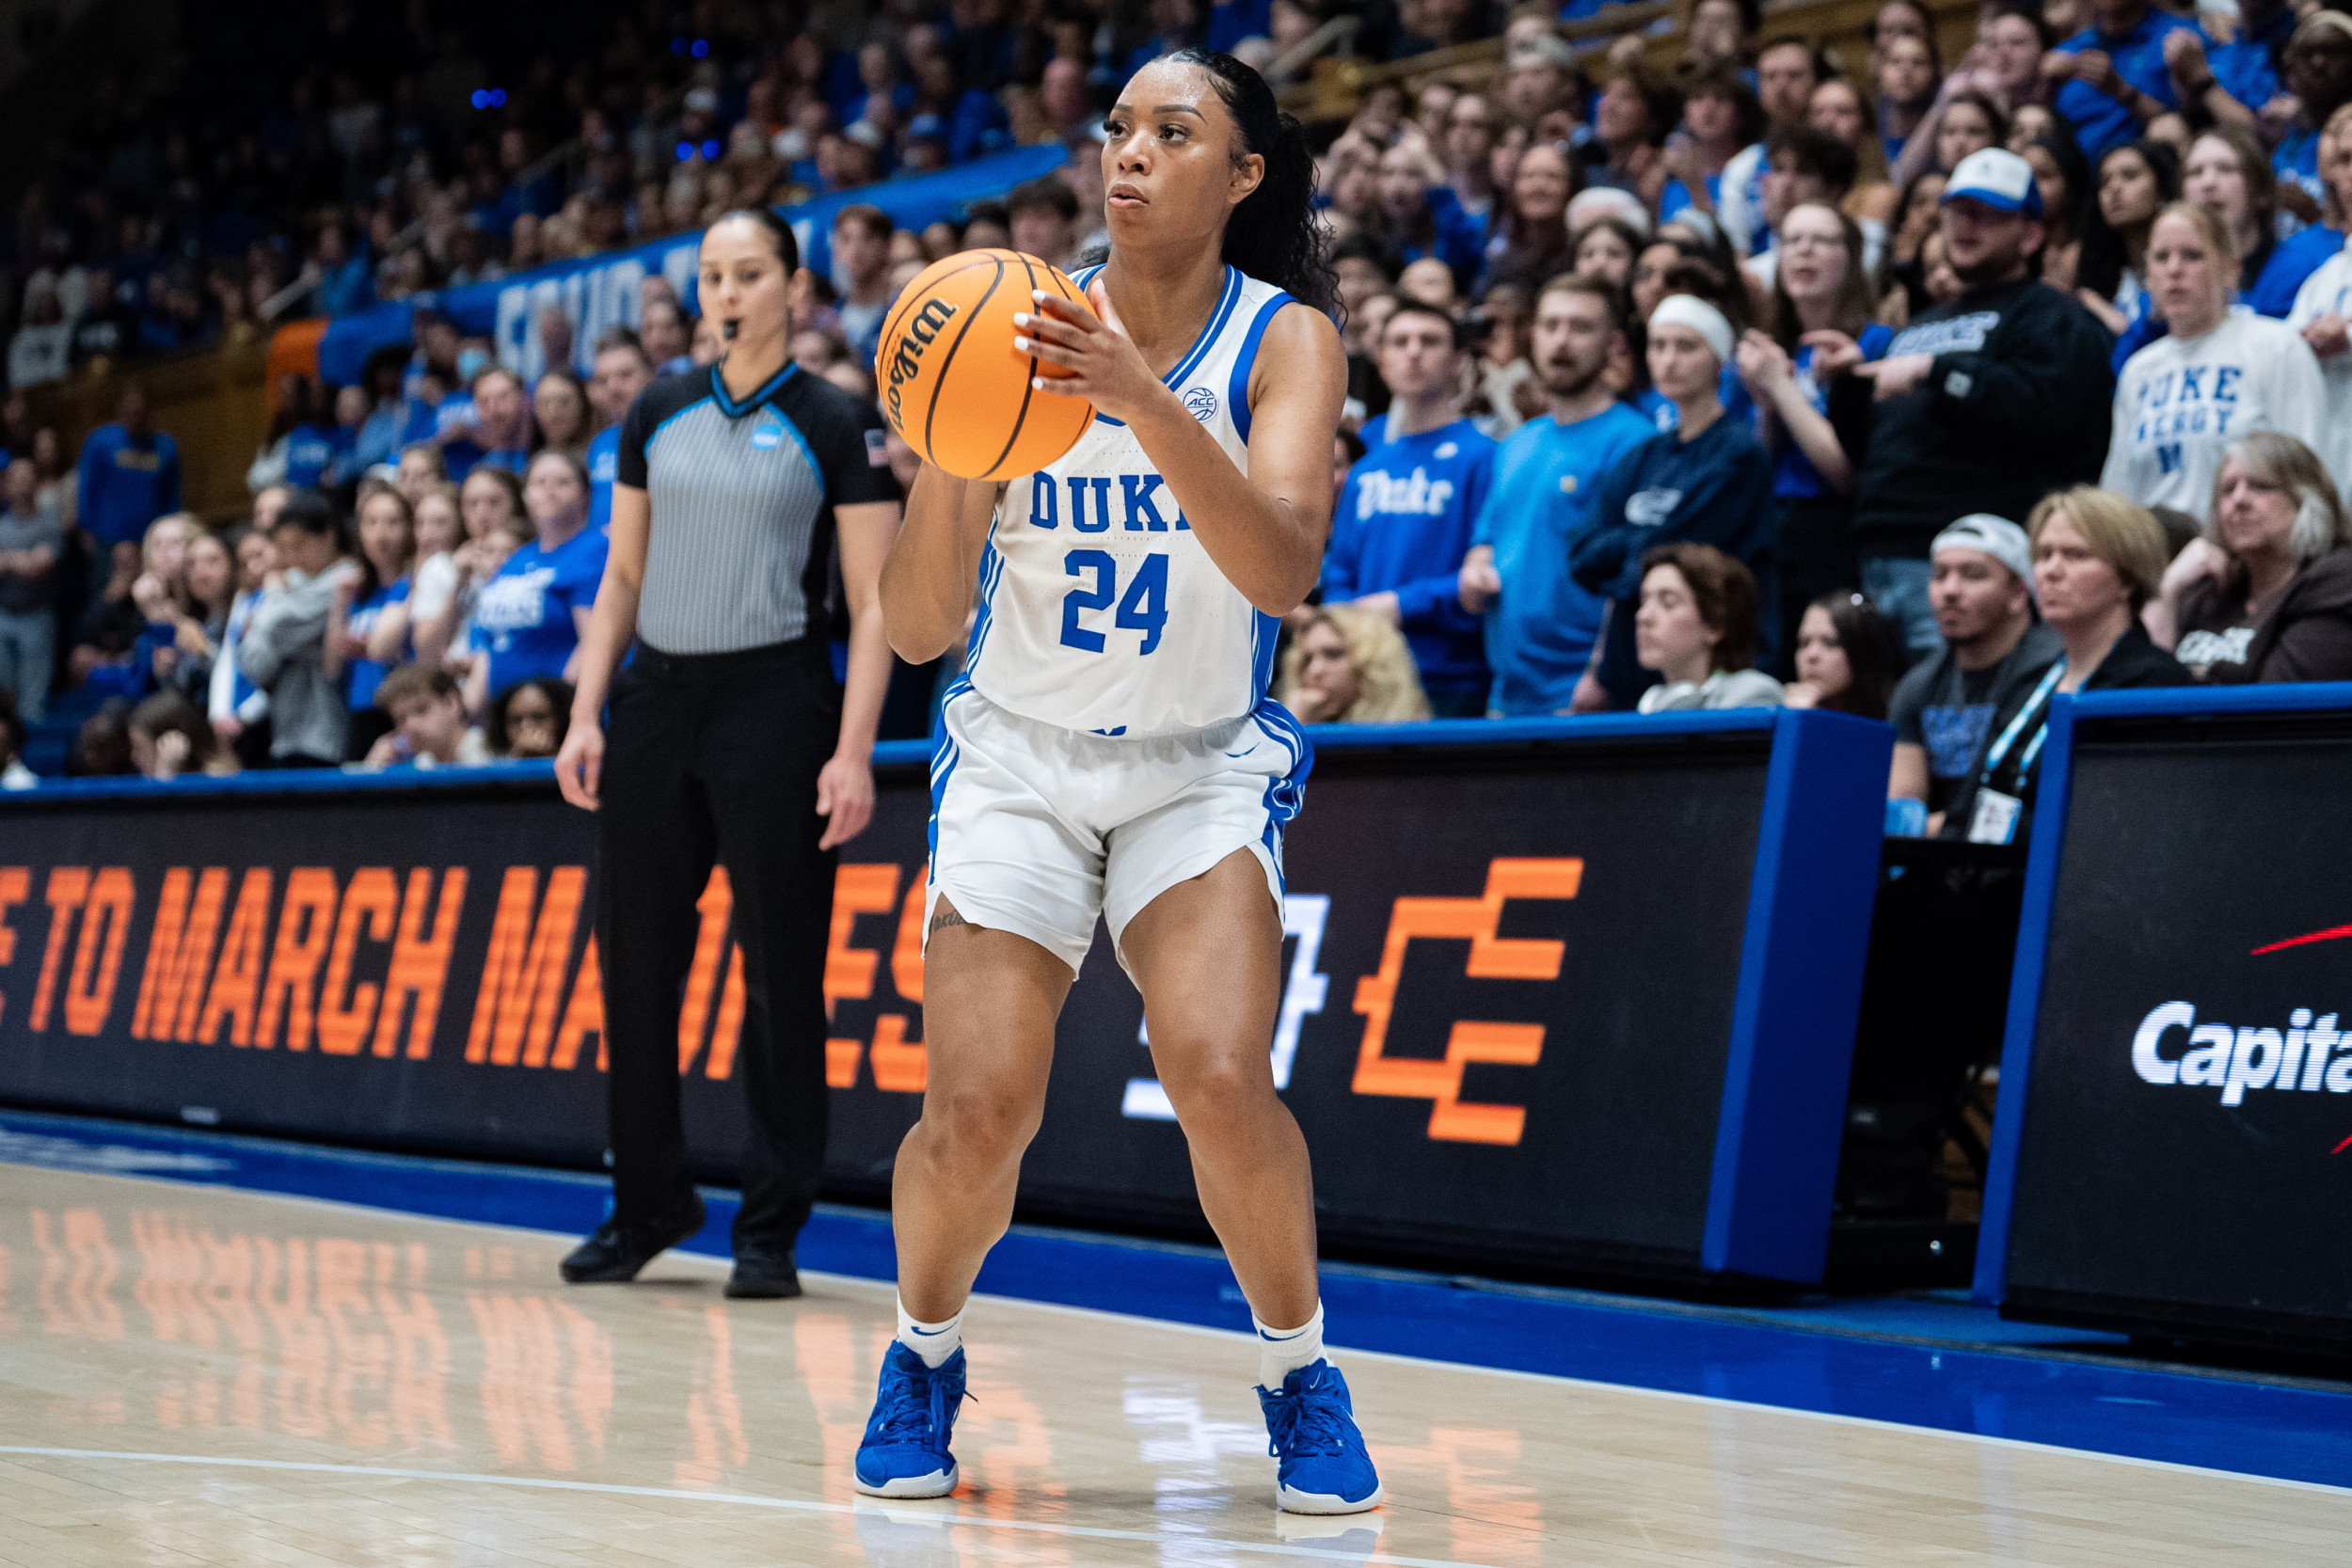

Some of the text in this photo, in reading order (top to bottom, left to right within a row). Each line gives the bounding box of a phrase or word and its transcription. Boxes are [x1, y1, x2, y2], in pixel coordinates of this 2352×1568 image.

[887, 296, 960, 432] Wilson
[1186, 397, 1215, 406] ACC
[1059, 548, 1169, 656] 24
[28, 865, 136, 1036] TO
[130, 865, 469, 1060] MARCH
